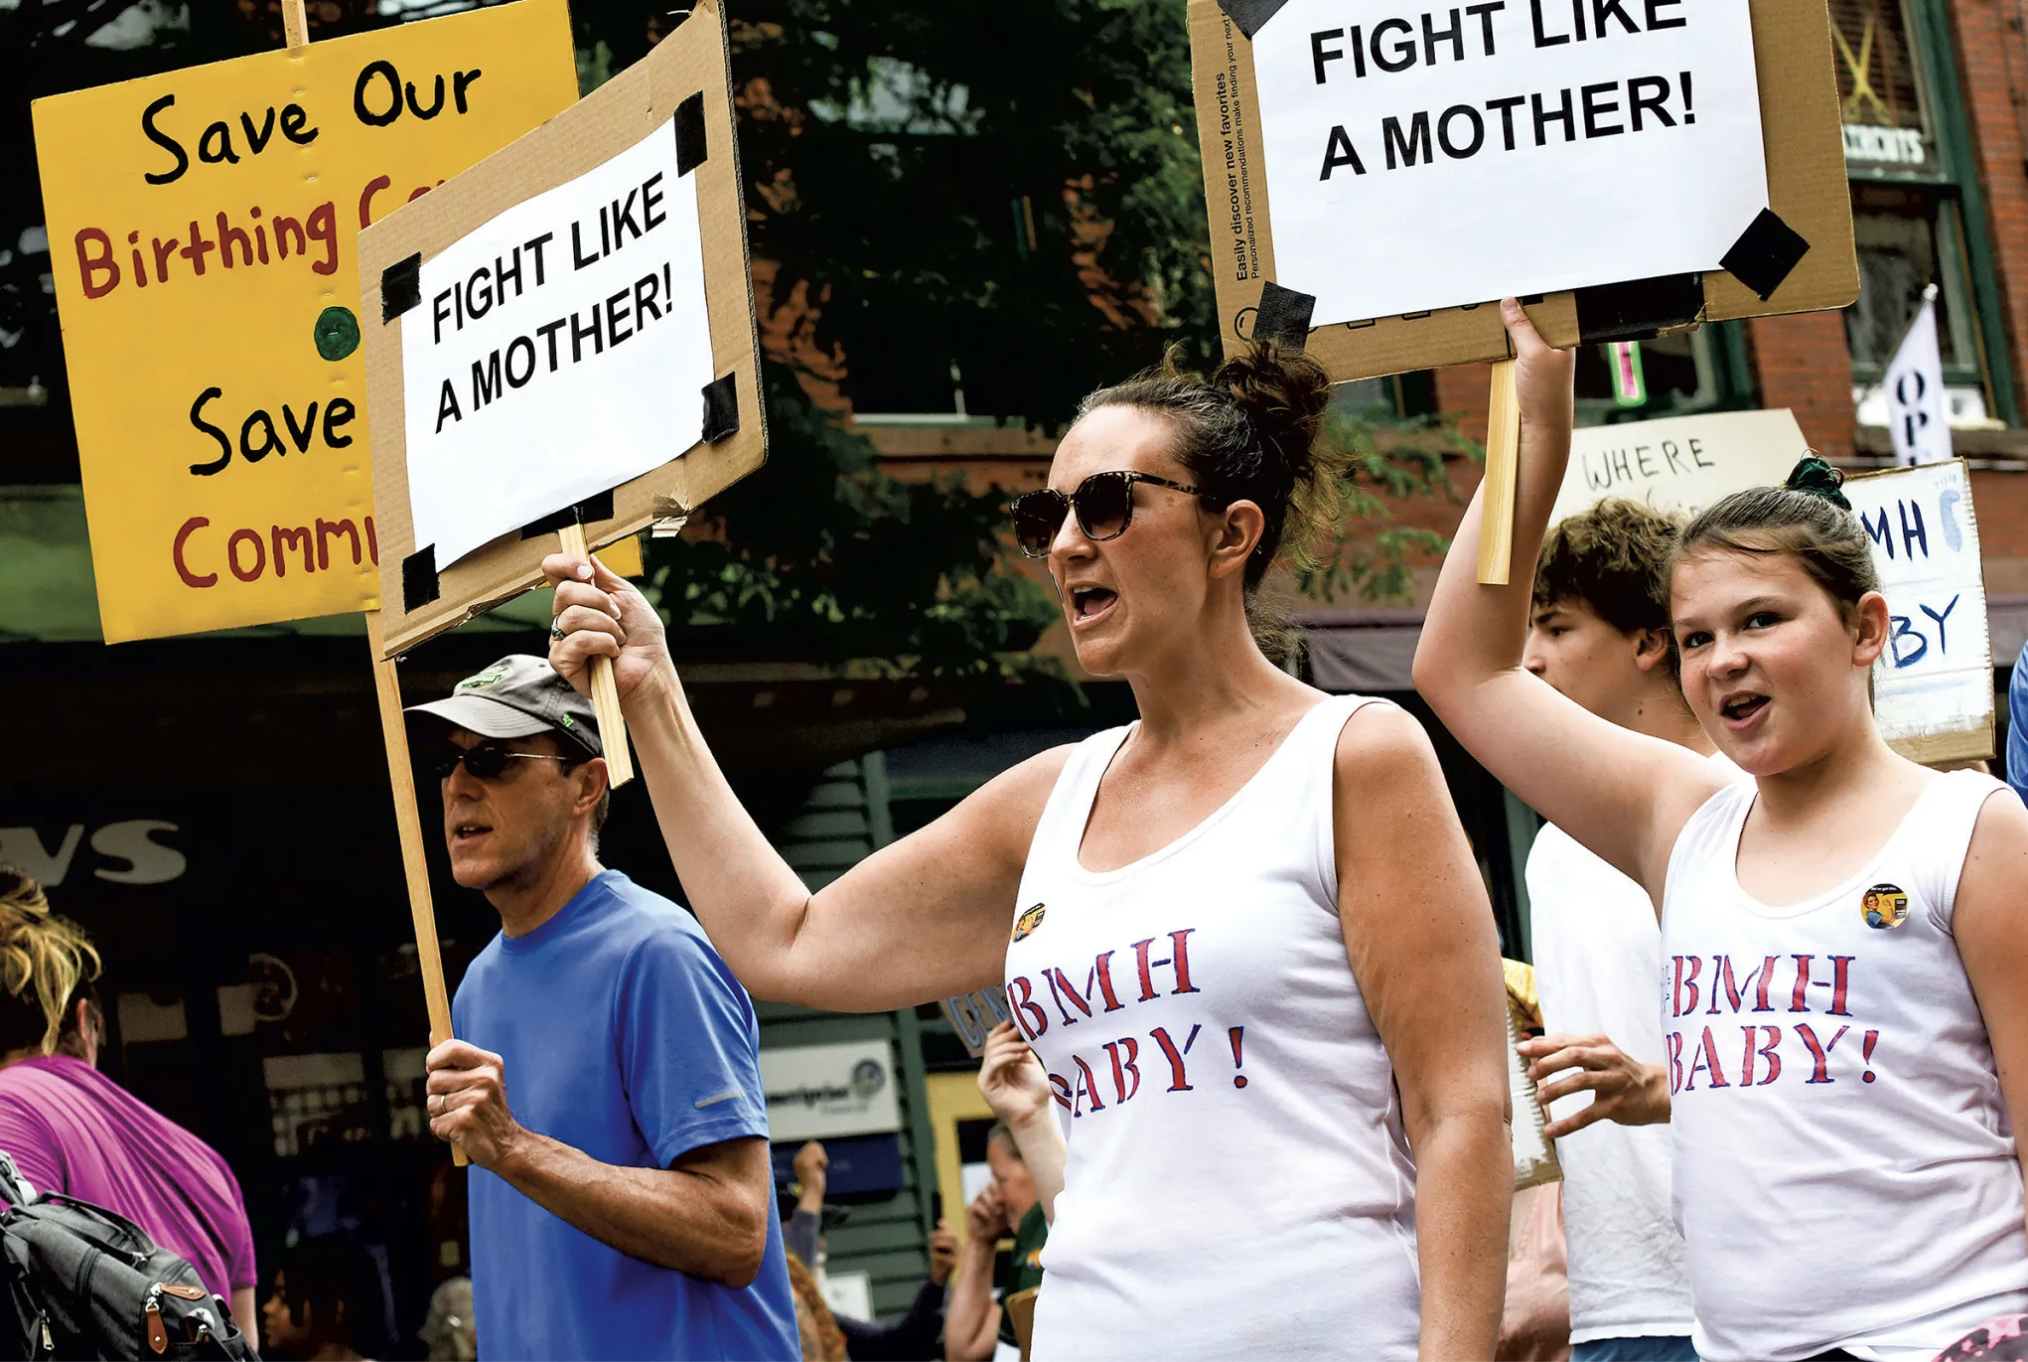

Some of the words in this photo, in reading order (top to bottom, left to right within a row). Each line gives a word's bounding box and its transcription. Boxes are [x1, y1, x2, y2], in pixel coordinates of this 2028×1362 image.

[1222, 19, 1232, 40] next
[1226, 42, 1237, 63] your
[1310, 1, 1505, 85] FIGHT
[1530, 0, 1687, 49] LIKE
[1216, 72, 1231, 136] favorites
[1229, 65, 1239, 98] finding
[1231, 100, 1242, 126] make
[141, 94, 319, 186] Save
[353, 60, 483, 127] Our
[1224, 139, 1235, 169] new
[1319, 124, 1367, 181] A
[1382, 71, 1695, 170] MOTHER!
[1228, 173, 1242, 235] discover
[1236, 129, 1252, 215] recommendations
[74, 201, 339, 300] Birthing
[433, 231, 553, 345] FIGHT
[571, 171, 666, 271] LIKE
[1234, 239, 1248, 281] Easily
[1245, 217, 1260, 279] Personalized
[435, 378, 462, 434] A
[471, 261, 672, 411] MOTHER!
[189, 387, 355, 476] Save
[1582, 438, 1715, 491] WHERE
[1861, 498, 1928, 562] MH
[1889, 594, 1960, 668] BY
[0, 819, 187, 887] VS
[1007, 928, 1200, 1041] BMH
